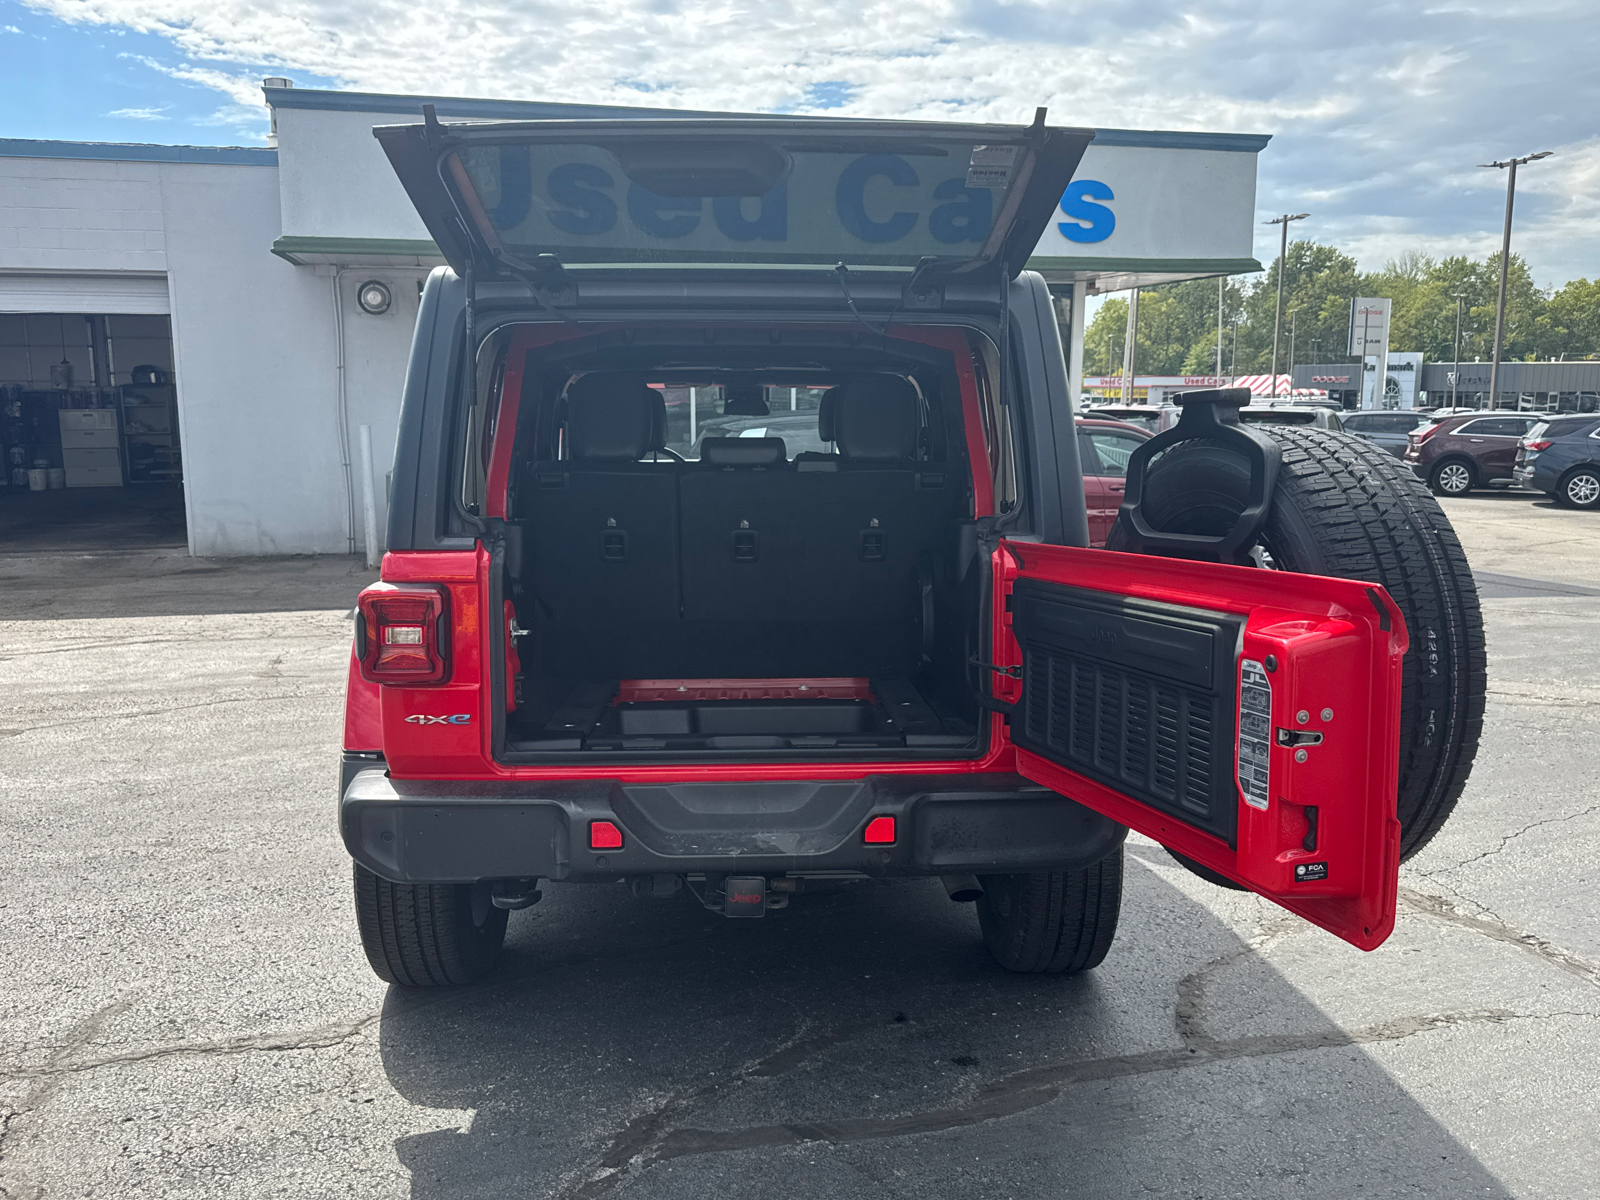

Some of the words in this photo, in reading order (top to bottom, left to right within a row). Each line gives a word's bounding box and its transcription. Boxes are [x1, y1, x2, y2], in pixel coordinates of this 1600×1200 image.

[836, 154, 1116, 243] Cas
[1364, 361, 1414, 371] Lamark
[1207, 377, 1226, 385] Cas
[1311, 375, 1350, 384] DODGE
[1243, 672, 1267, 684] JL
[1308, 864, 1324, 872] FCA
[729, 892, 761, 905] Jeep
